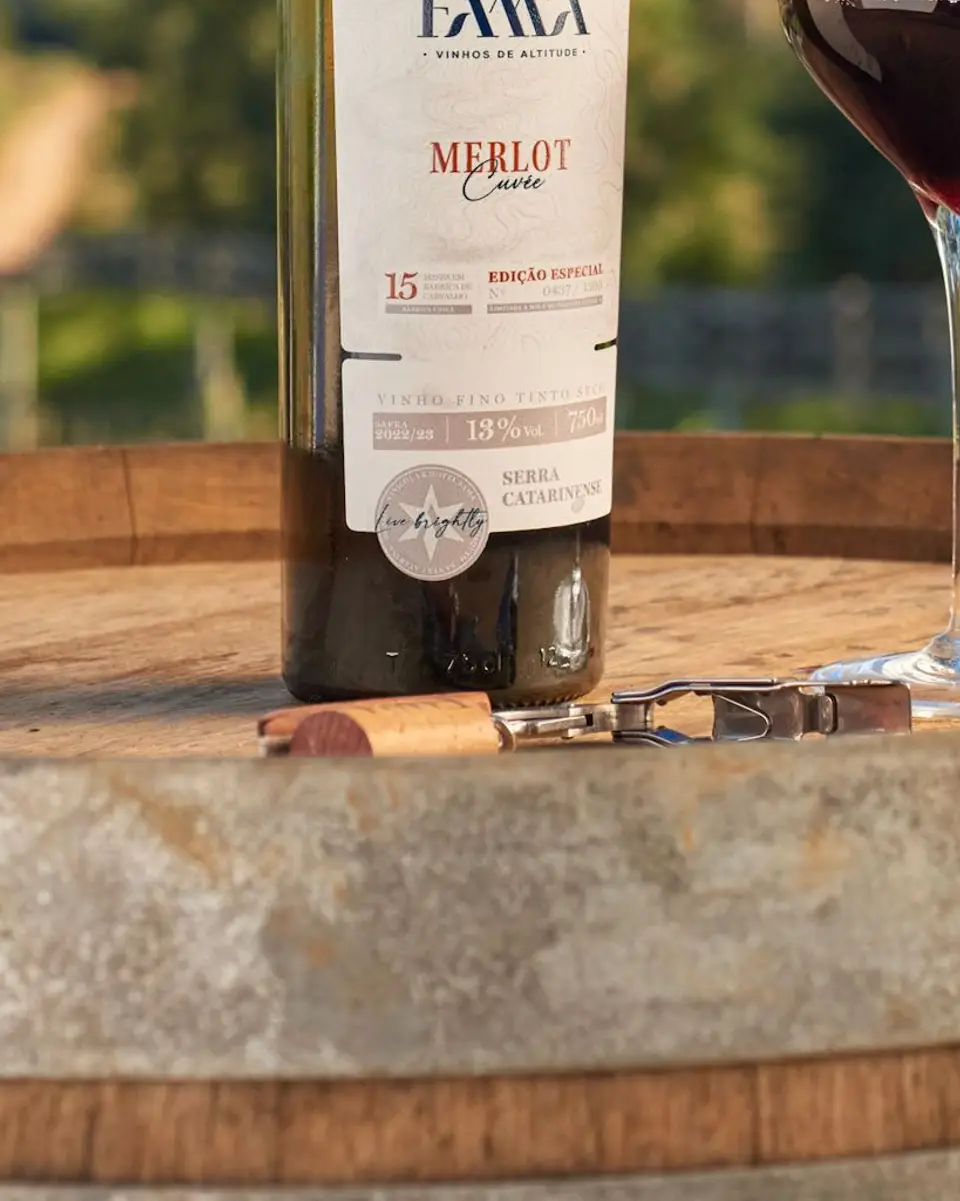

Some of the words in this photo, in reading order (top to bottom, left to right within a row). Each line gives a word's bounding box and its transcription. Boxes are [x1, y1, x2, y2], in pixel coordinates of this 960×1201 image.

[436, 50, 491, 60] VINHOS
[497, 50, 515, 59] DE
[520, 48, 579, 59] ALTITUDE
[430, 139, 571, 174] MERLOT
[462, 159, 546, 202] Cuvée
[487, 266, 547, 284] EDIÇÃO
[550, 263, 604, 280] ESPECIAL
[384, 271, 419, 301] 15
[377, 393, 444, 406] VINHO
[456, 392, 506, 406] FINO
[515, 389, 570, 404] TINTO
[523, 423, 544, 437] Vol.
[502, 467, 560, 487] SERRA
[501, 479, 603, 507] CATARINENSE
[374, 503, 407, 534] Live
[414, 507, 489, 538] brightly
